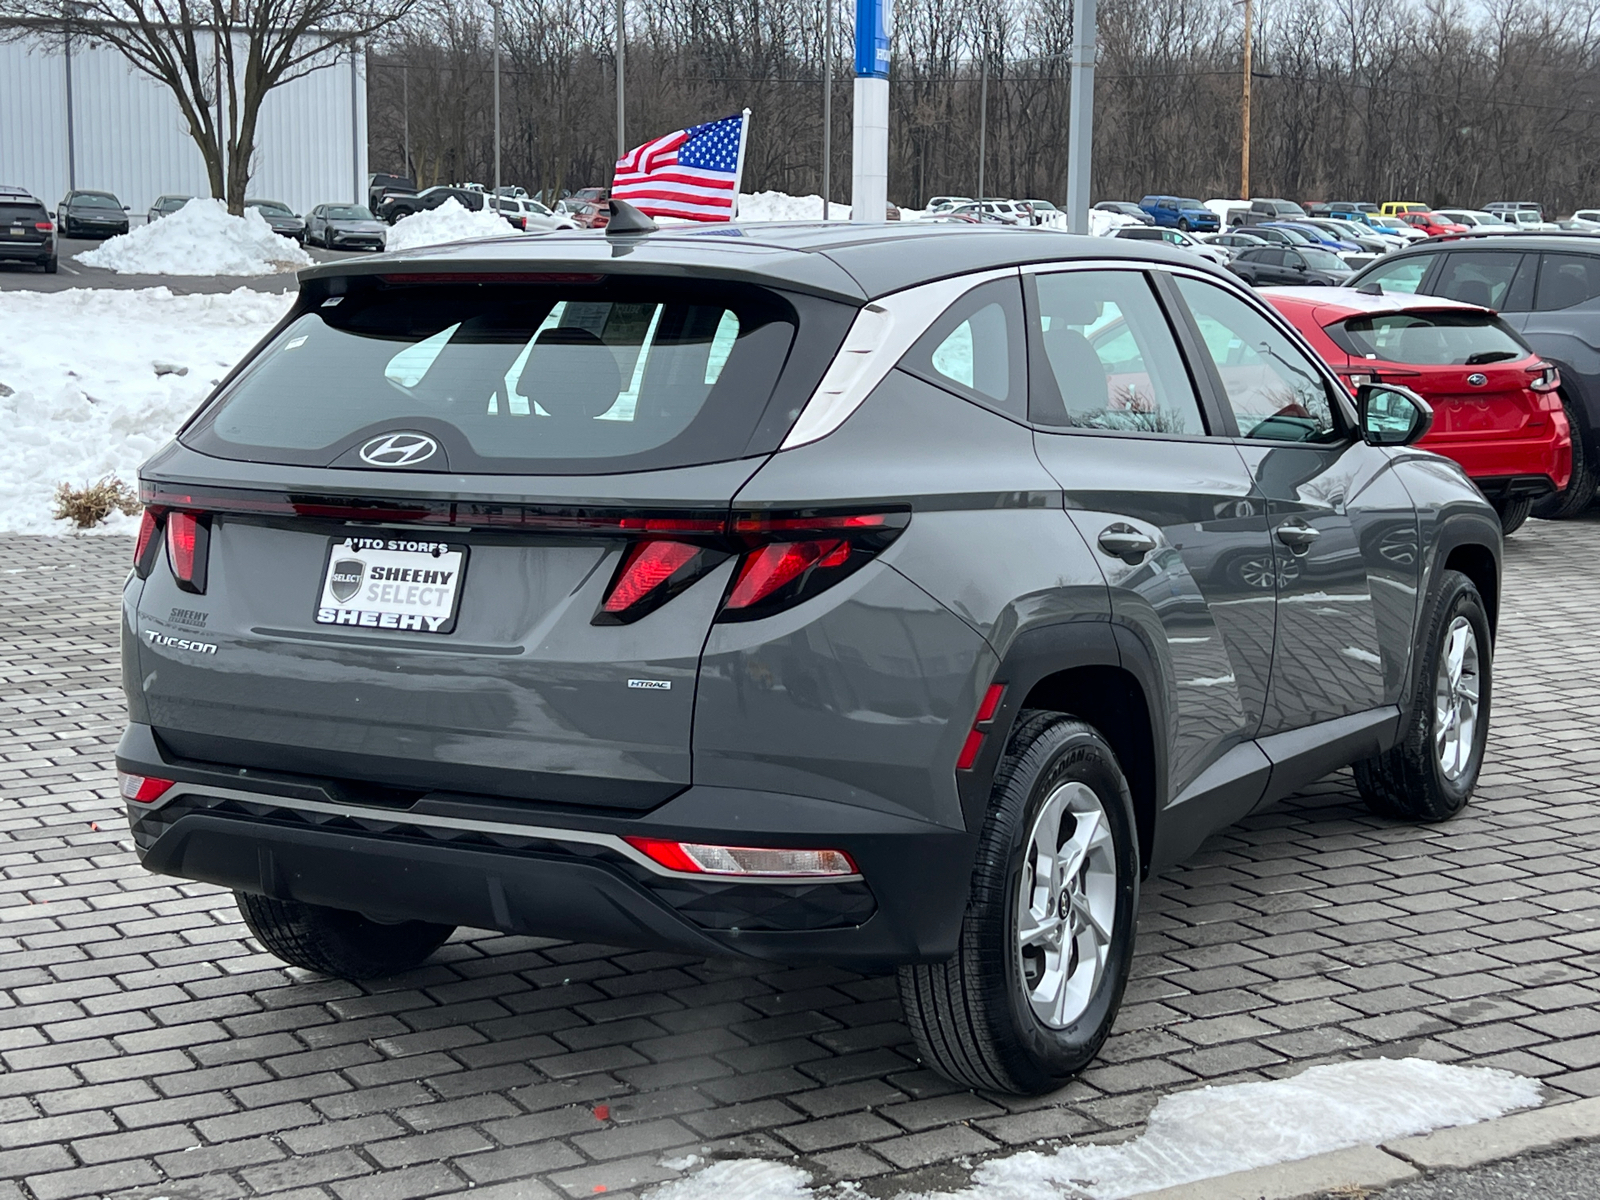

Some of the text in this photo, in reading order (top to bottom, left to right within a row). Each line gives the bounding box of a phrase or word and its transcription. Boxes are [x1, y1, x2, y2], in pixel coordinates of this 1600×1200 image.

[343, 537, 449, 553] AUTO STORES
[332, 573, 362, 583] SELECT
[370, 566, 454, 585] SHEEHY
[366, 583, 450, 607] SELECT
[170, 608, 209, 621] SHEEHY
[317, 608, 449, 632] SHEEHY
